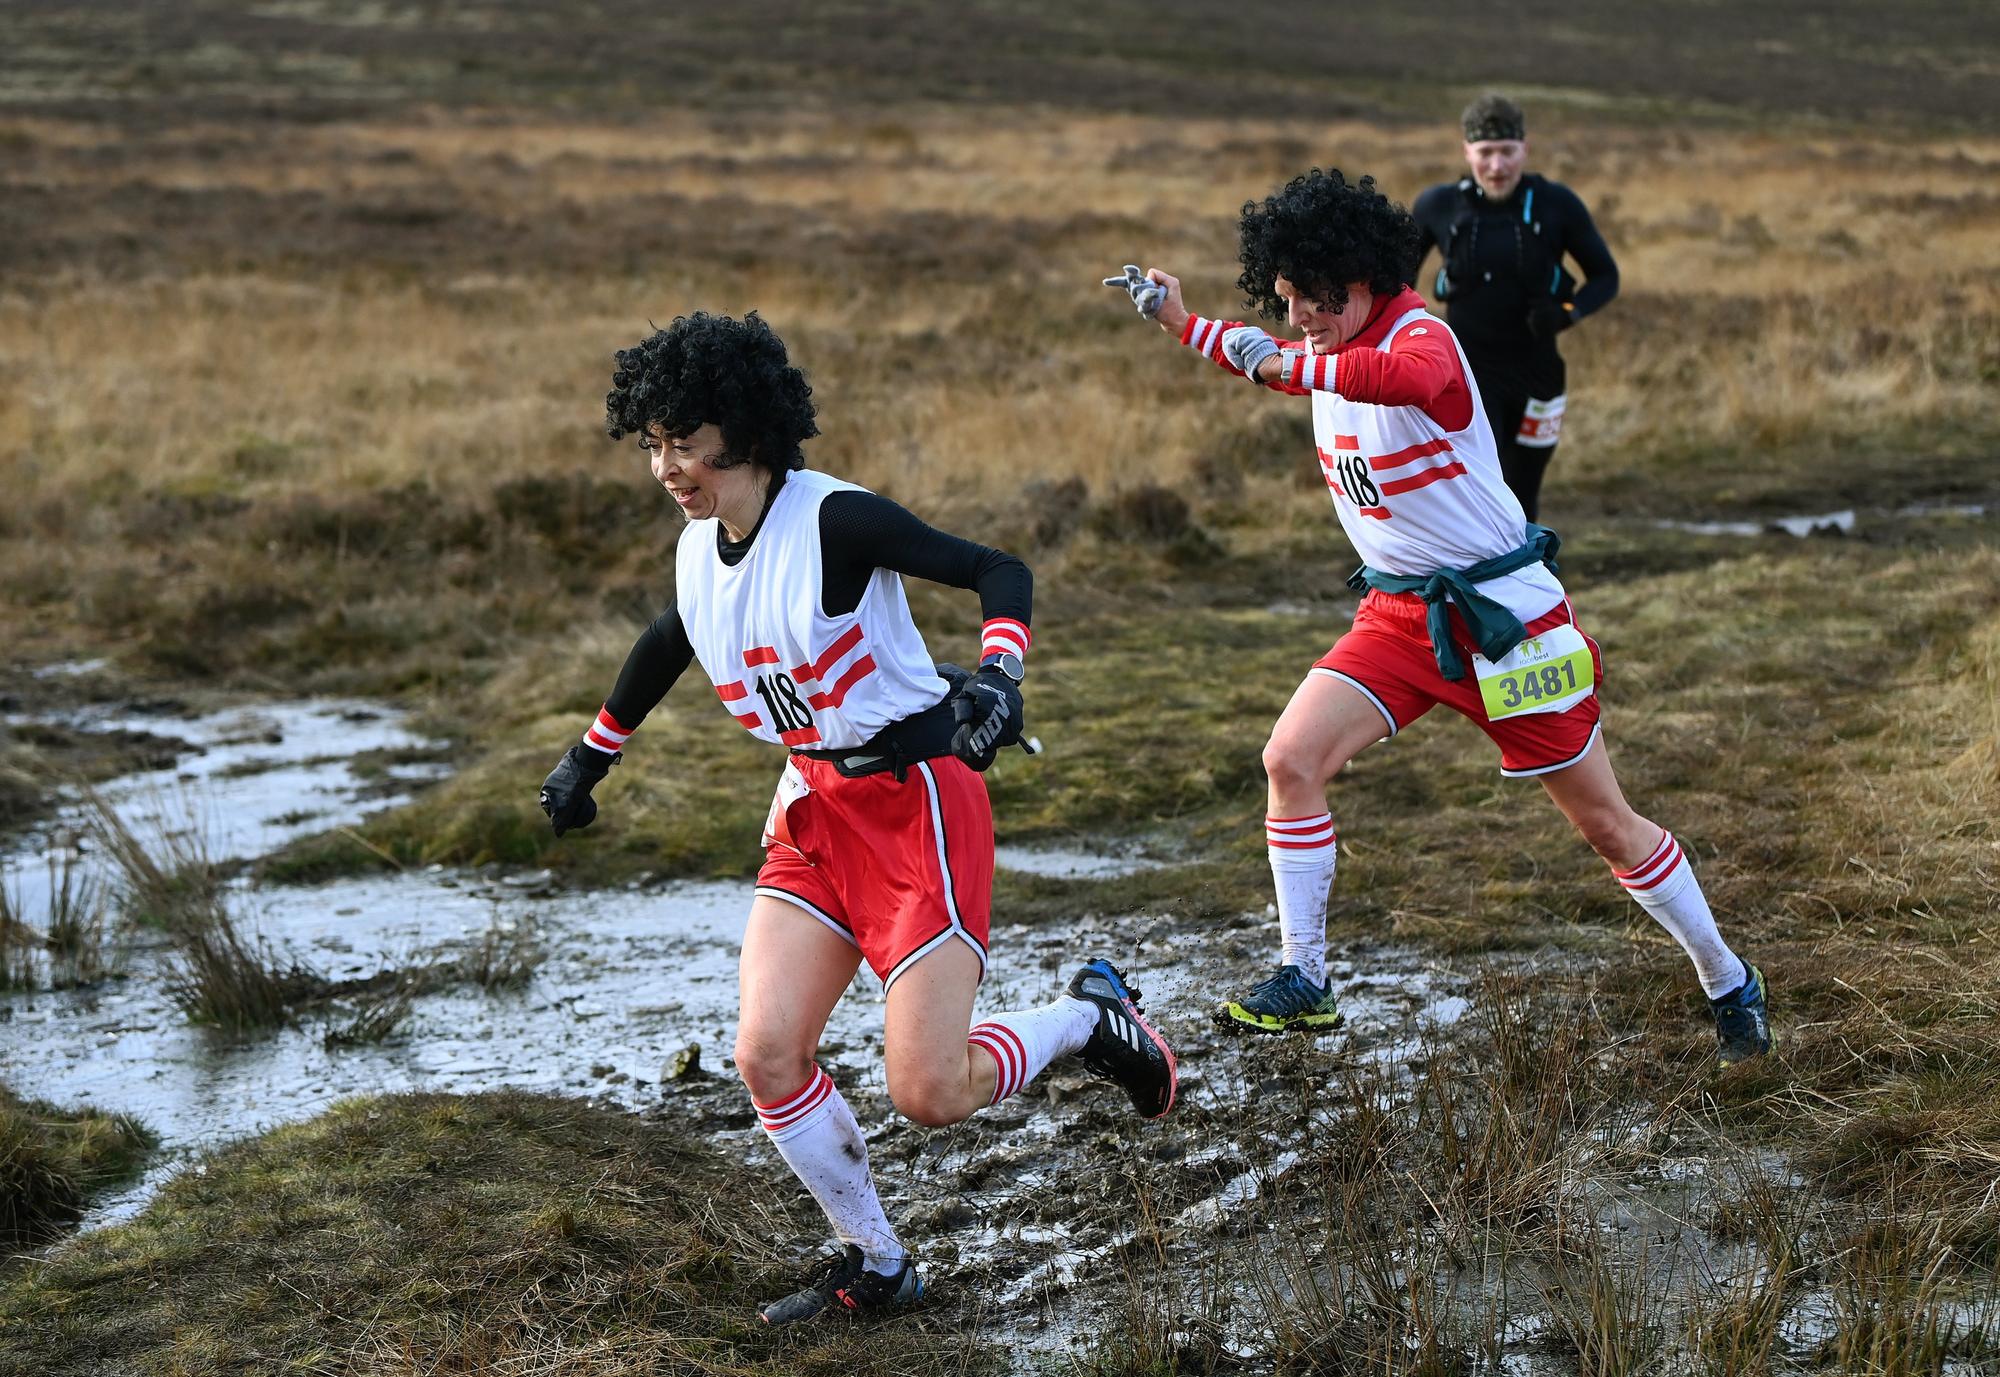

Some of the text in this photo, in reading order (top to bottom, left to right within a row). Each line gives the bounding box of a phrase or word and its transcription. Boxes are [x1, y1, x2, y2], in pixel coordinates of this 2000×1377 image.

[1337, 455, 1379, 507] 118
[756, 673, 814, 734] 118
[1500, 660, 1576, 708] 3481
